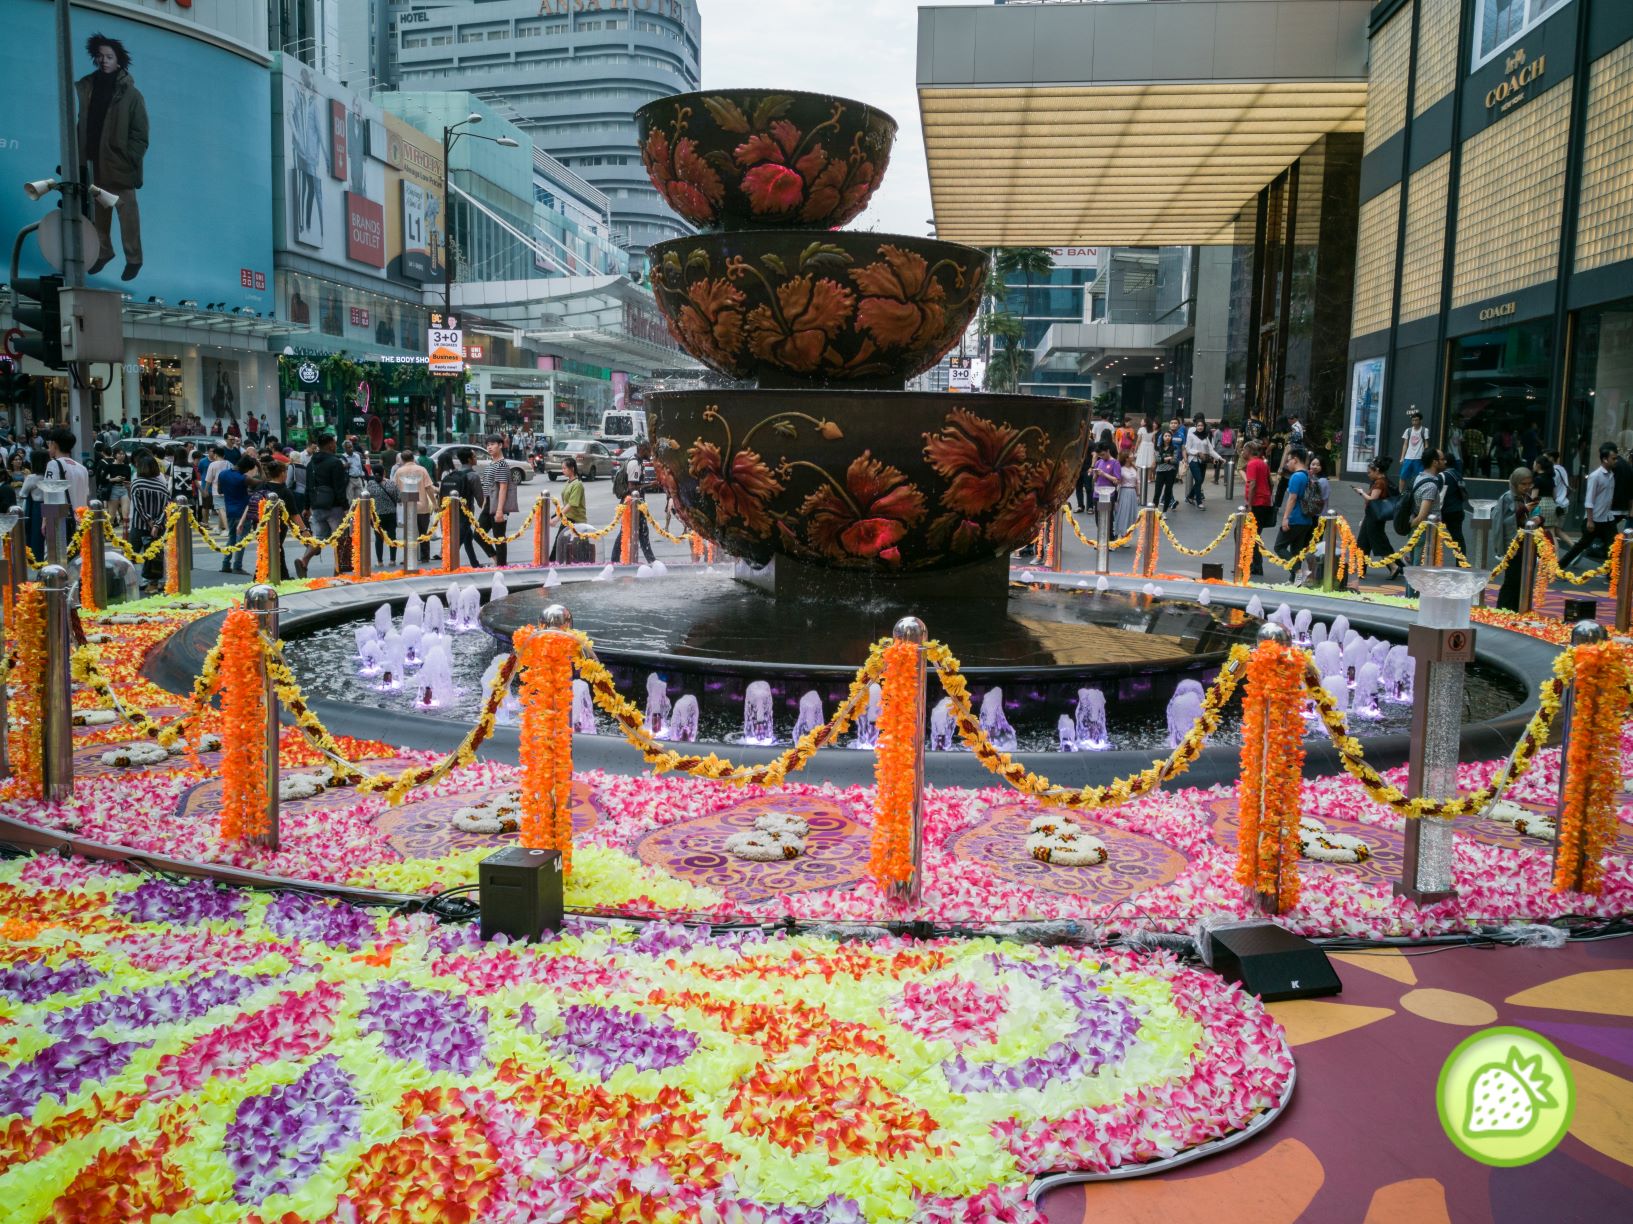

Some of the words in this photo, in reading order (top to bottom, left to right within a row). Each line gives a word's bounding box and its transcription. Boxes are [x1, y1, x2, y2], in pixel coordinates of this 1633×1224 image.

[400, 12, 429, 24] HOTEL
[1485, 55, 1545, 108] COACH
[352, 212, 380, 235] BRANDS
[408, 212, 421, 243] L1
[353, 228, 379, 249] OUTLET
[1067, 248, 1097, 256] BAN
[1479, 302, 1516, 321] COACH
[433, 331, 458, 343] 3+0
[952, 370, 969, 378] 3+0
[1290, 980, 1300, 989] K
